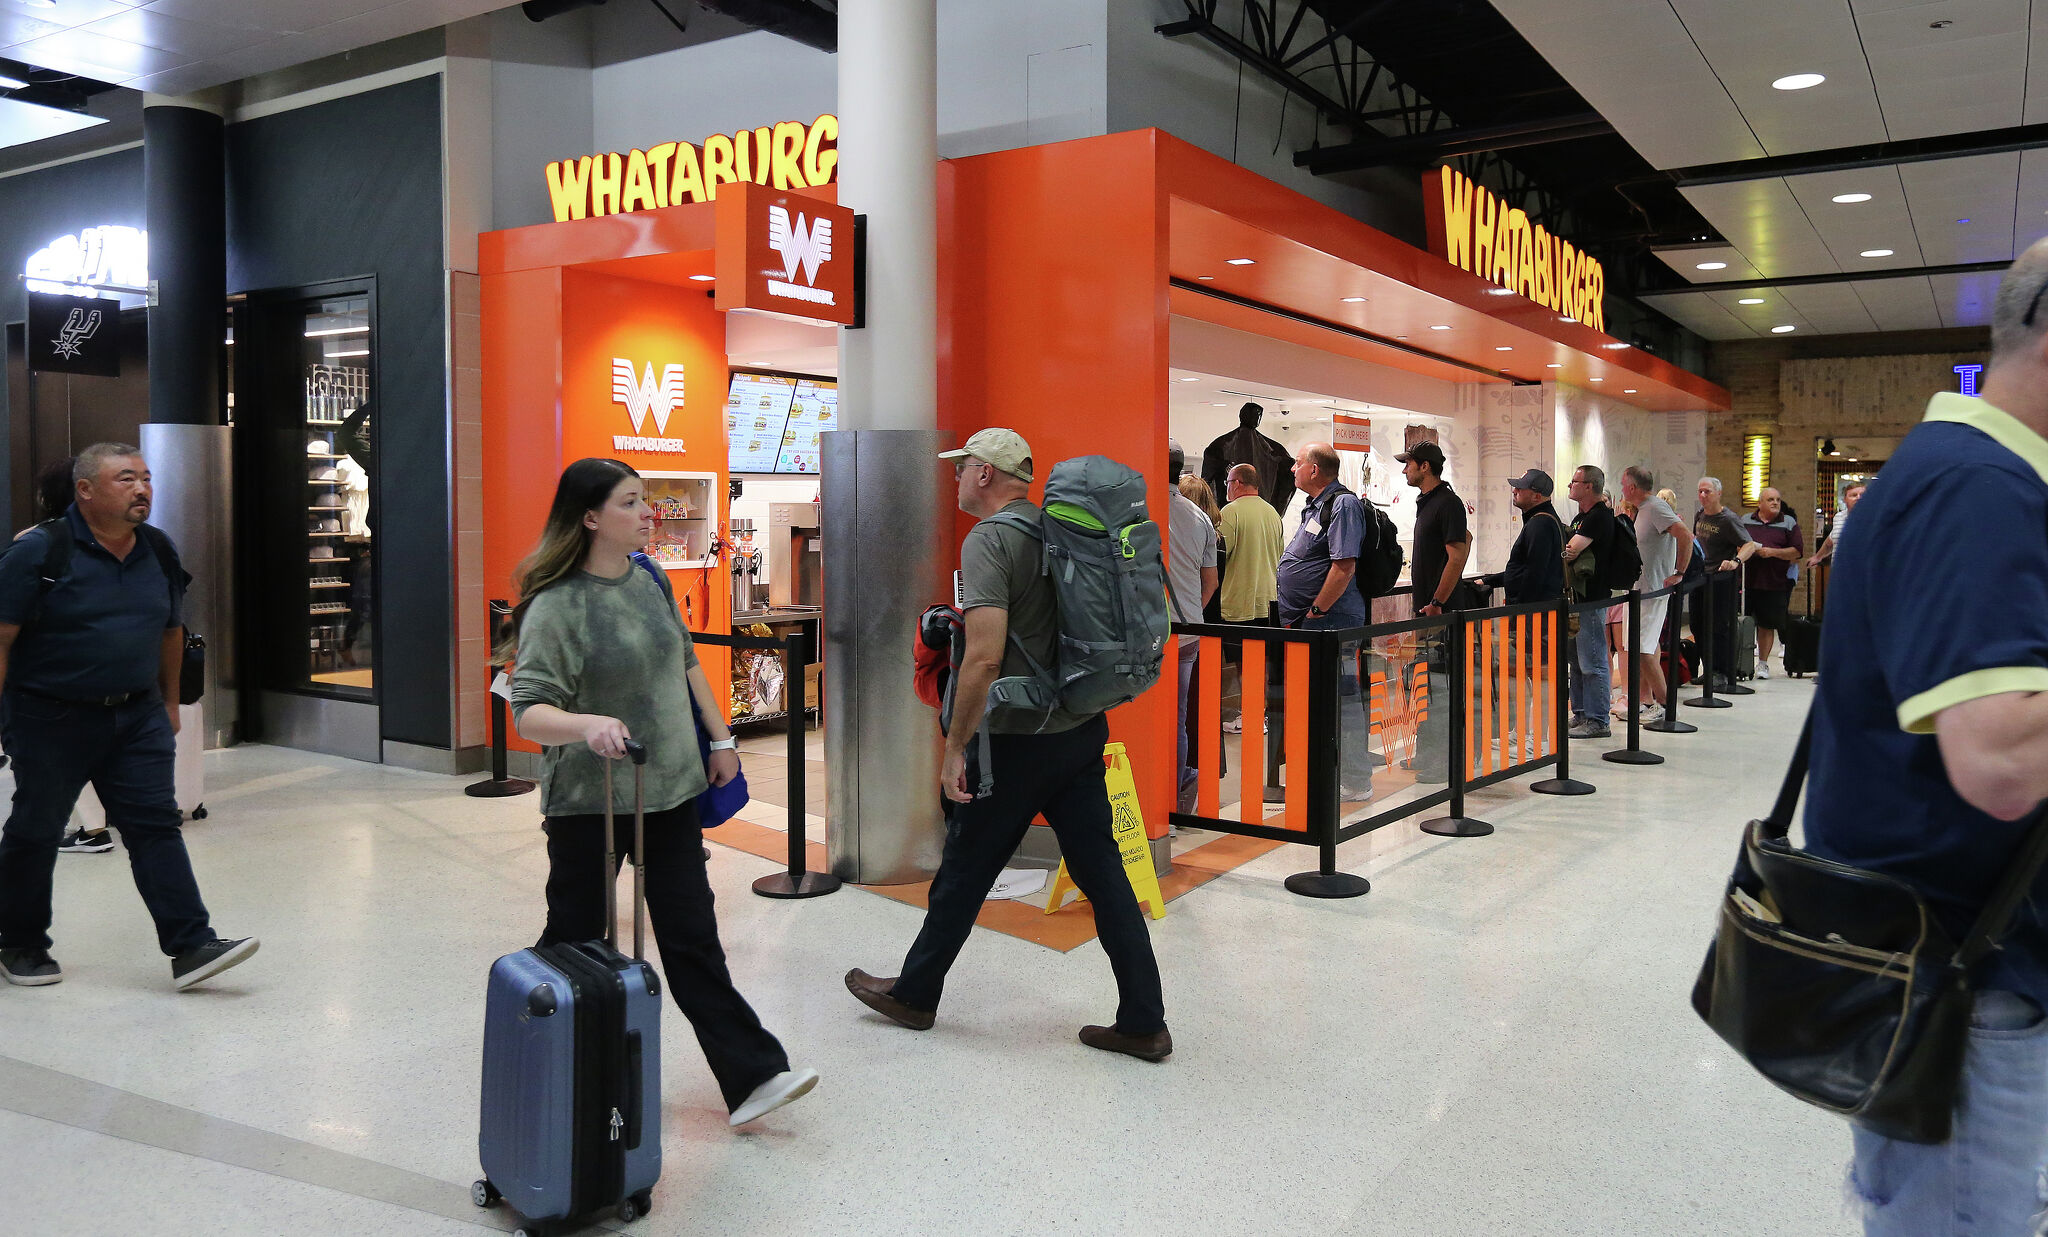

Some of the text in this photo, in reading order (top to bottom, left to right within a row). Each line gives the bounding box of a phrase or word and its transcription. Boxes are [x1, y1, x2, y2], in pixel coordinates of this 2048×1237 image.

[1442, 165, 1604, 333] WHATABURGER
[768, 280, 836, 306] WHATABURGER
[613, 435, 687, 453] WHATABURGER
[1336, 428, 1368, 440] PICK UP HERE
[1110, 791, 1130, 801] CAUTION
[1113, 803, 1121, 834] CUIDADO
[1123, 801, 1139, 827] ACHTUNG
[1117, 831, 1140, 843] WET FLOOR
